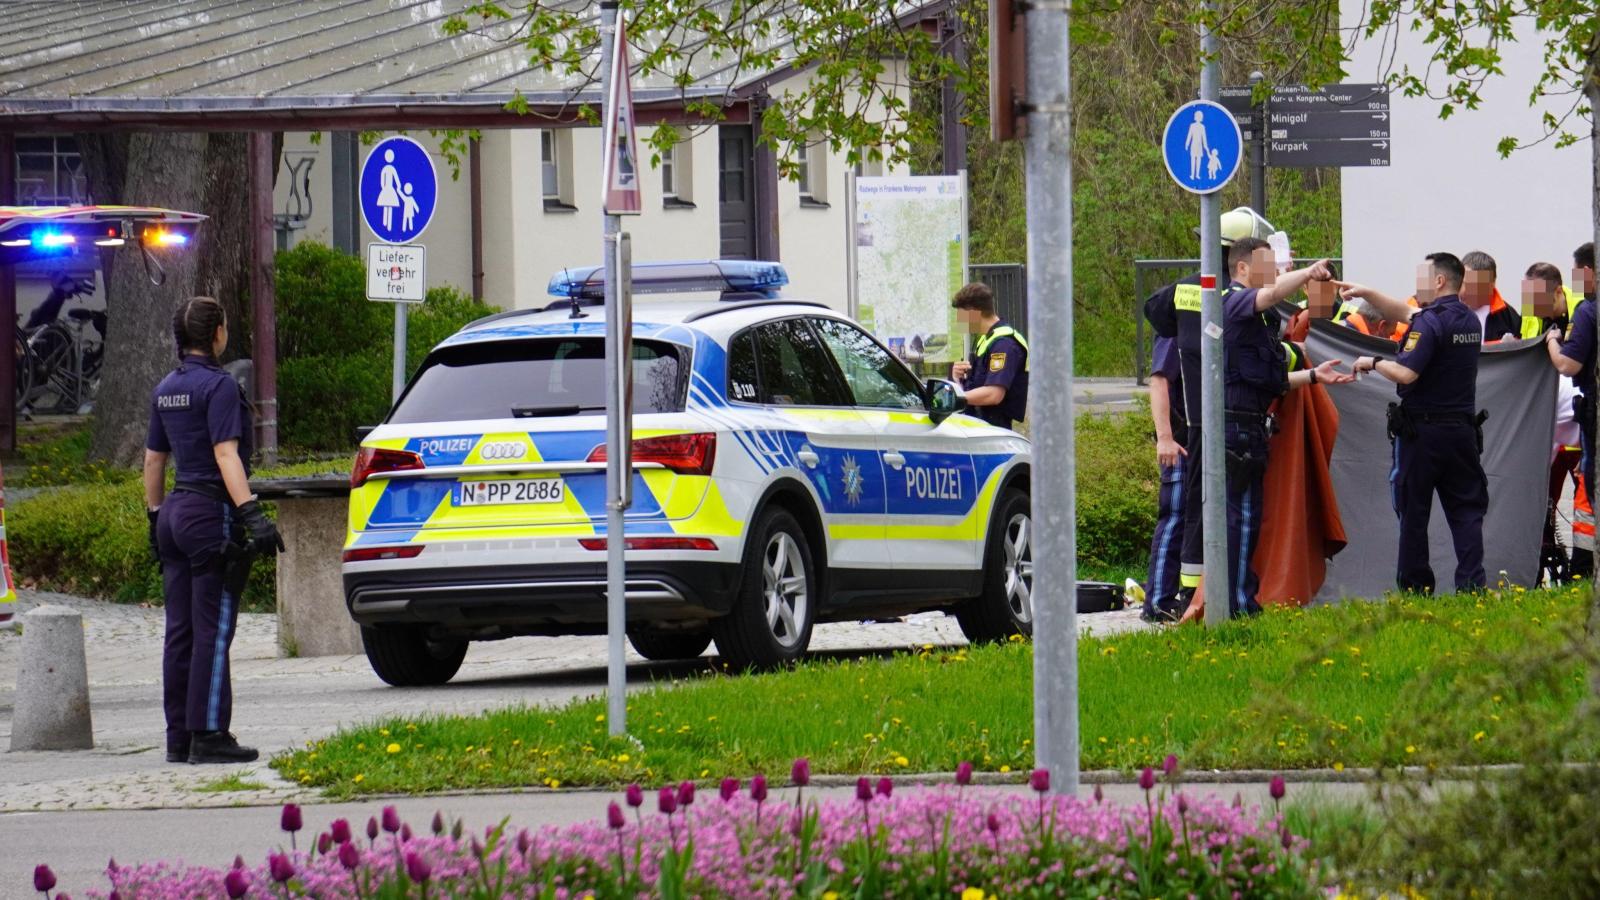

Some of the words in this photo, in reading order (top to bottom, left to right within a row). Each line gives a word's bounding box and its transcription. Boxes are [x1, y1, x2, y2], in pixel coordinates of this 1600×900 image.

[1296, 95, 1328, 103] Kongress
[1271, 114, 1307, 125] Minigolf
[1271, 142, 1308, 152] Kurpark
[379, 250, 414, 263] Liefer-
[376, 266, 416, 279] verehr
[387, 281, 405, 294] frei
[741, 383, 756, 397] 110
[158, 394, 190, 408] POLIZEI
[420, 438, 472, 453] POLIZEI
[905, 466, 962, 500] POLIZEI
[463, 484, 475, 503] N
[488, 483, 511, 501] PP
[515, 481, 560, 501] 2086
